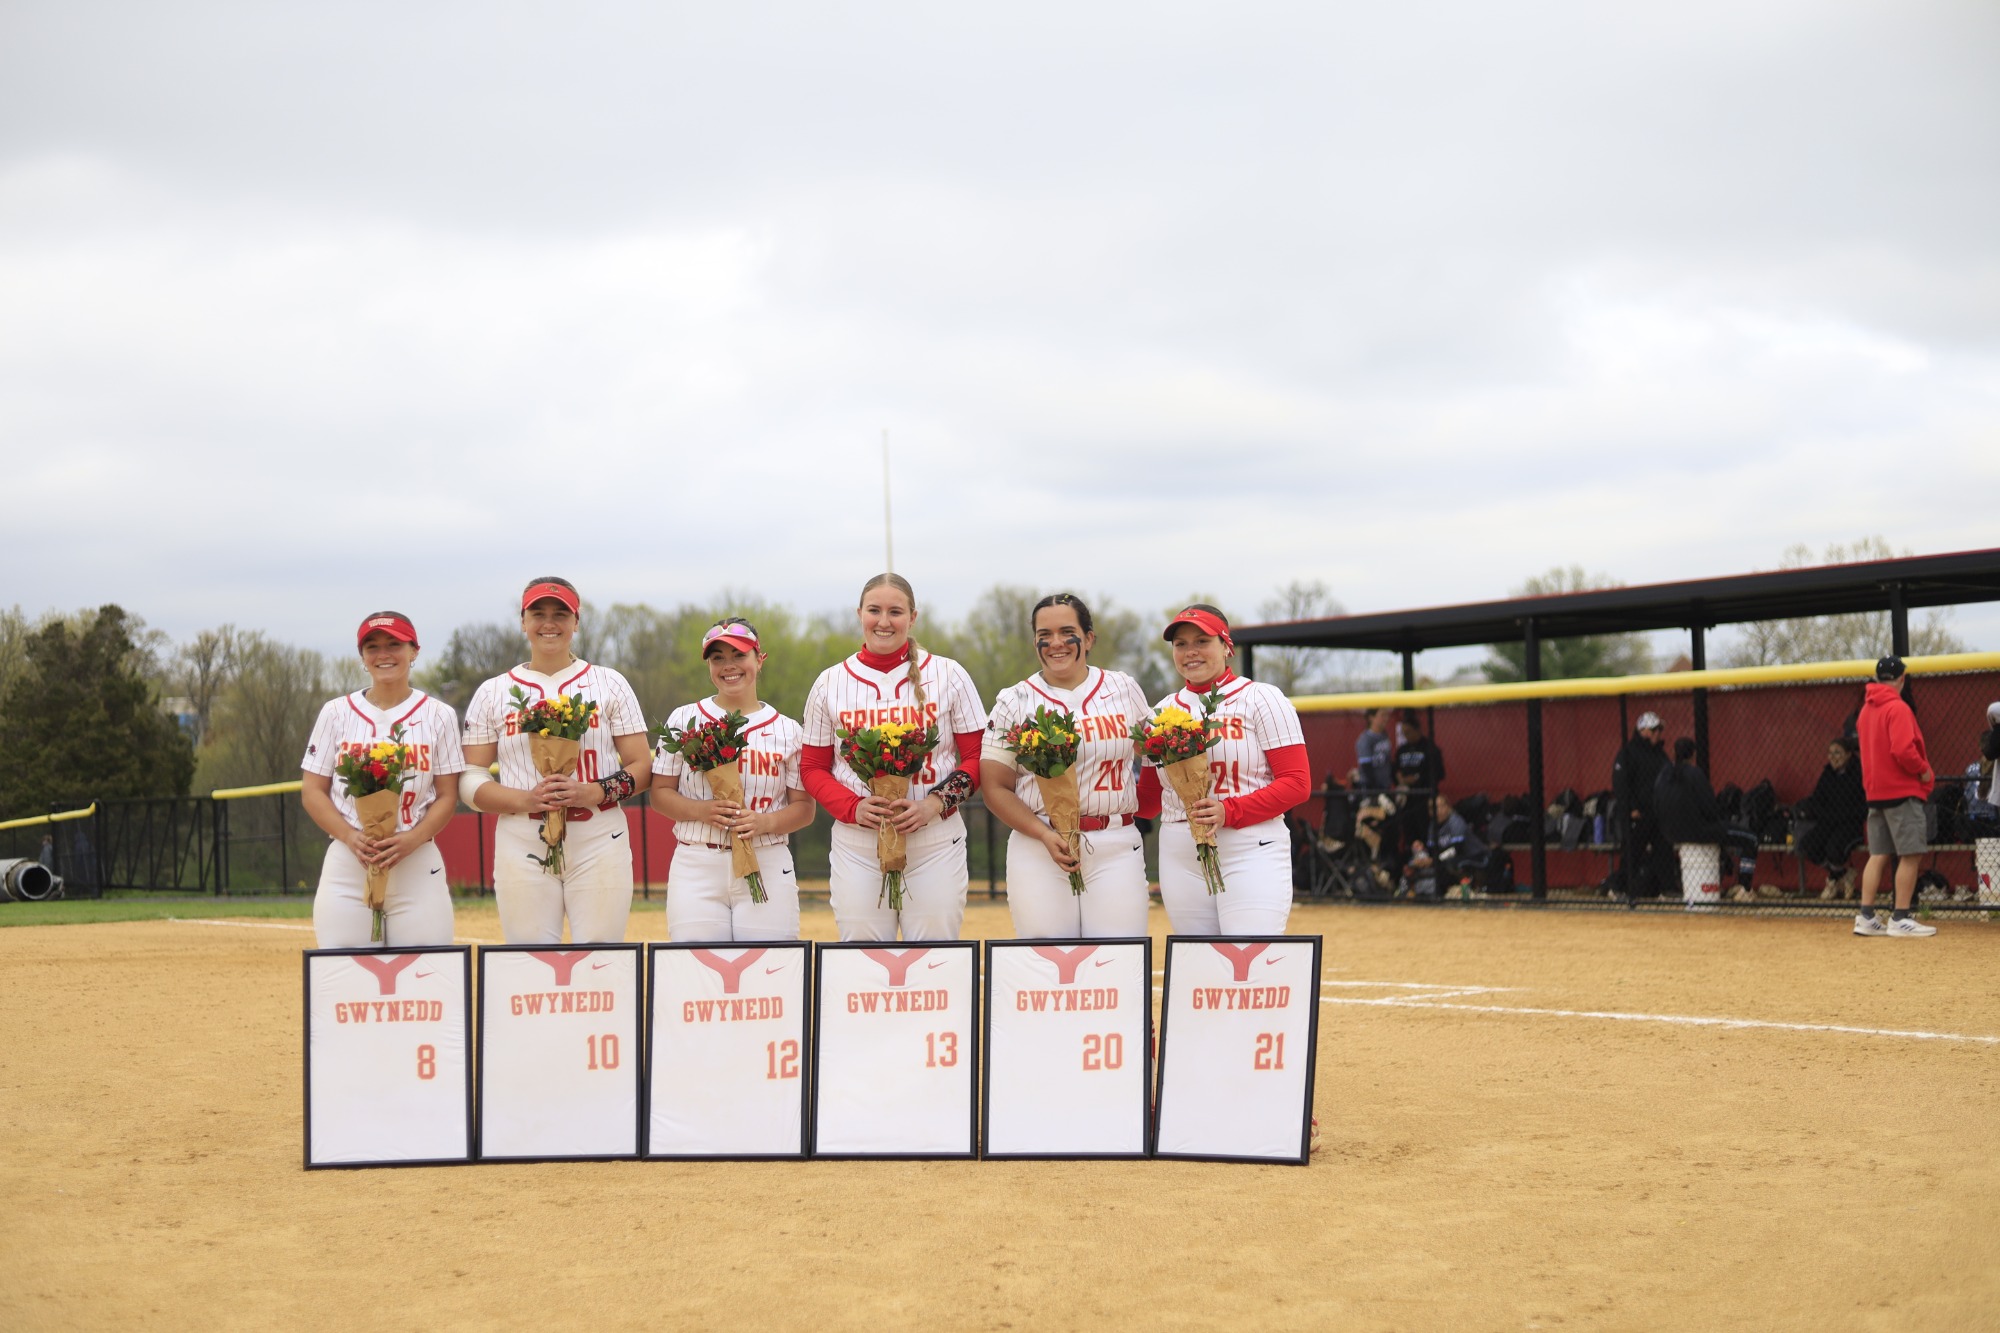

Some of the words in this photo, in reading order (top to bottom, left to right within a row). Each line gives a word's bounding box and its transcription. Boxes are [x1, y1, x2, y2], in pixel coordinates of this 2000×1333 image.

[839, 702, 938, 732] GRIFFINS
[1094, 758, 1125, 792] 20
[1210, 760, 1241, 795] 21
[401, 791, 416, 824] 8
[335, 999, 444, 1025] GWYNEDD
[509, 990, 615, 1016] GWYNEDD
[682, 995, 784, 1024] GWYNEDD
[847, 989, 949, 1014] GWYNEDD
[1015, 987, 1119, 1013] GWYNEDD
[1192, 985, 1292, 1011] GWYNEDD
[416, 1043, 437, 1081] 8
[586, 1033, 621, 1071] 10
[766, 1038, 800, 1080] 12
[925, 1031, 959, 1068] 13
[1082, 1032, 1124, 1072] 20
[1253, 1031, 1286, 1071] 21
